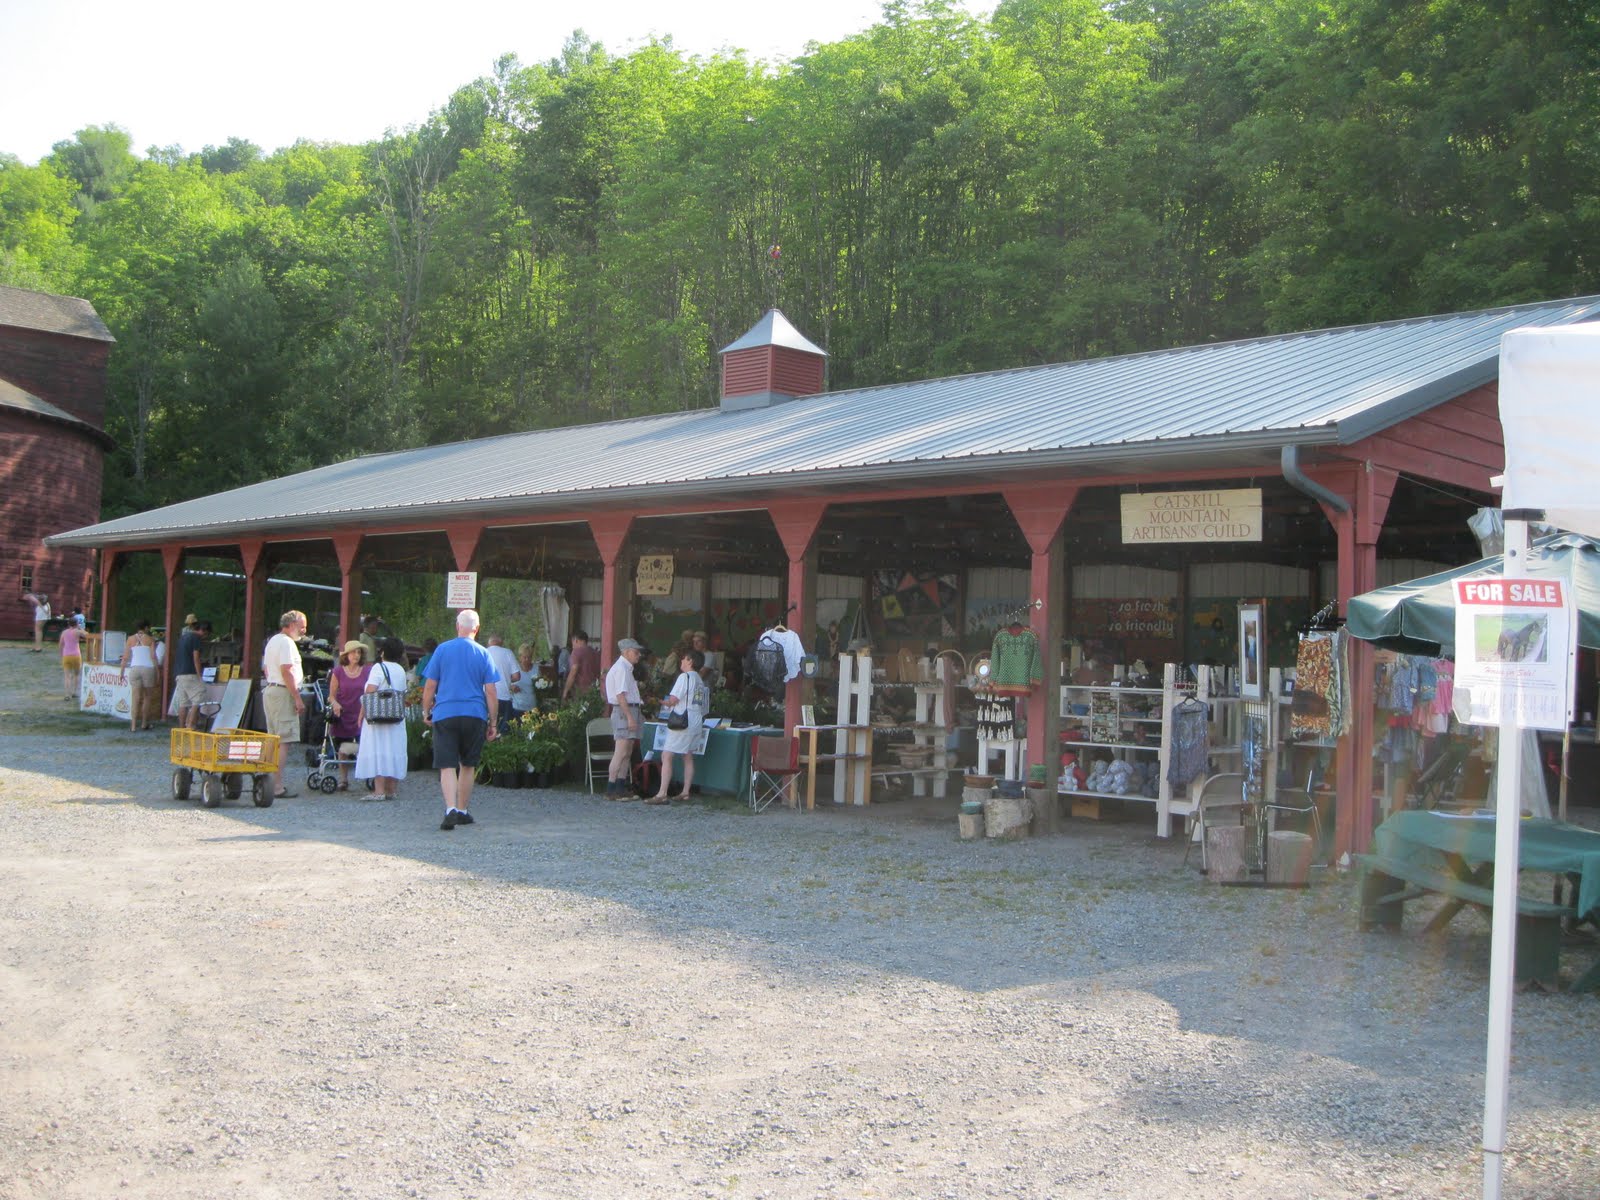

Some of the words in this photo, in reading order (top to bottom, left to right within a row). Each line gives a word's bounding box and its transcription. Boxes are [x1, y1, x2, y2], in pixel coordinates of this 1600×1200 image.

[1153, 493, 1224, 509] CATSKILL
[1150, 508, 1230, 524] MOUNTAIN
[1203, 523, 1251, 538] GUILD
[1465, 583, 1503, 601] FOR
[1509, 584, 1557, 603] SALE
[1135, 600, 1164, 612] fresh
[1126, 619, 1174, 637] friendly
